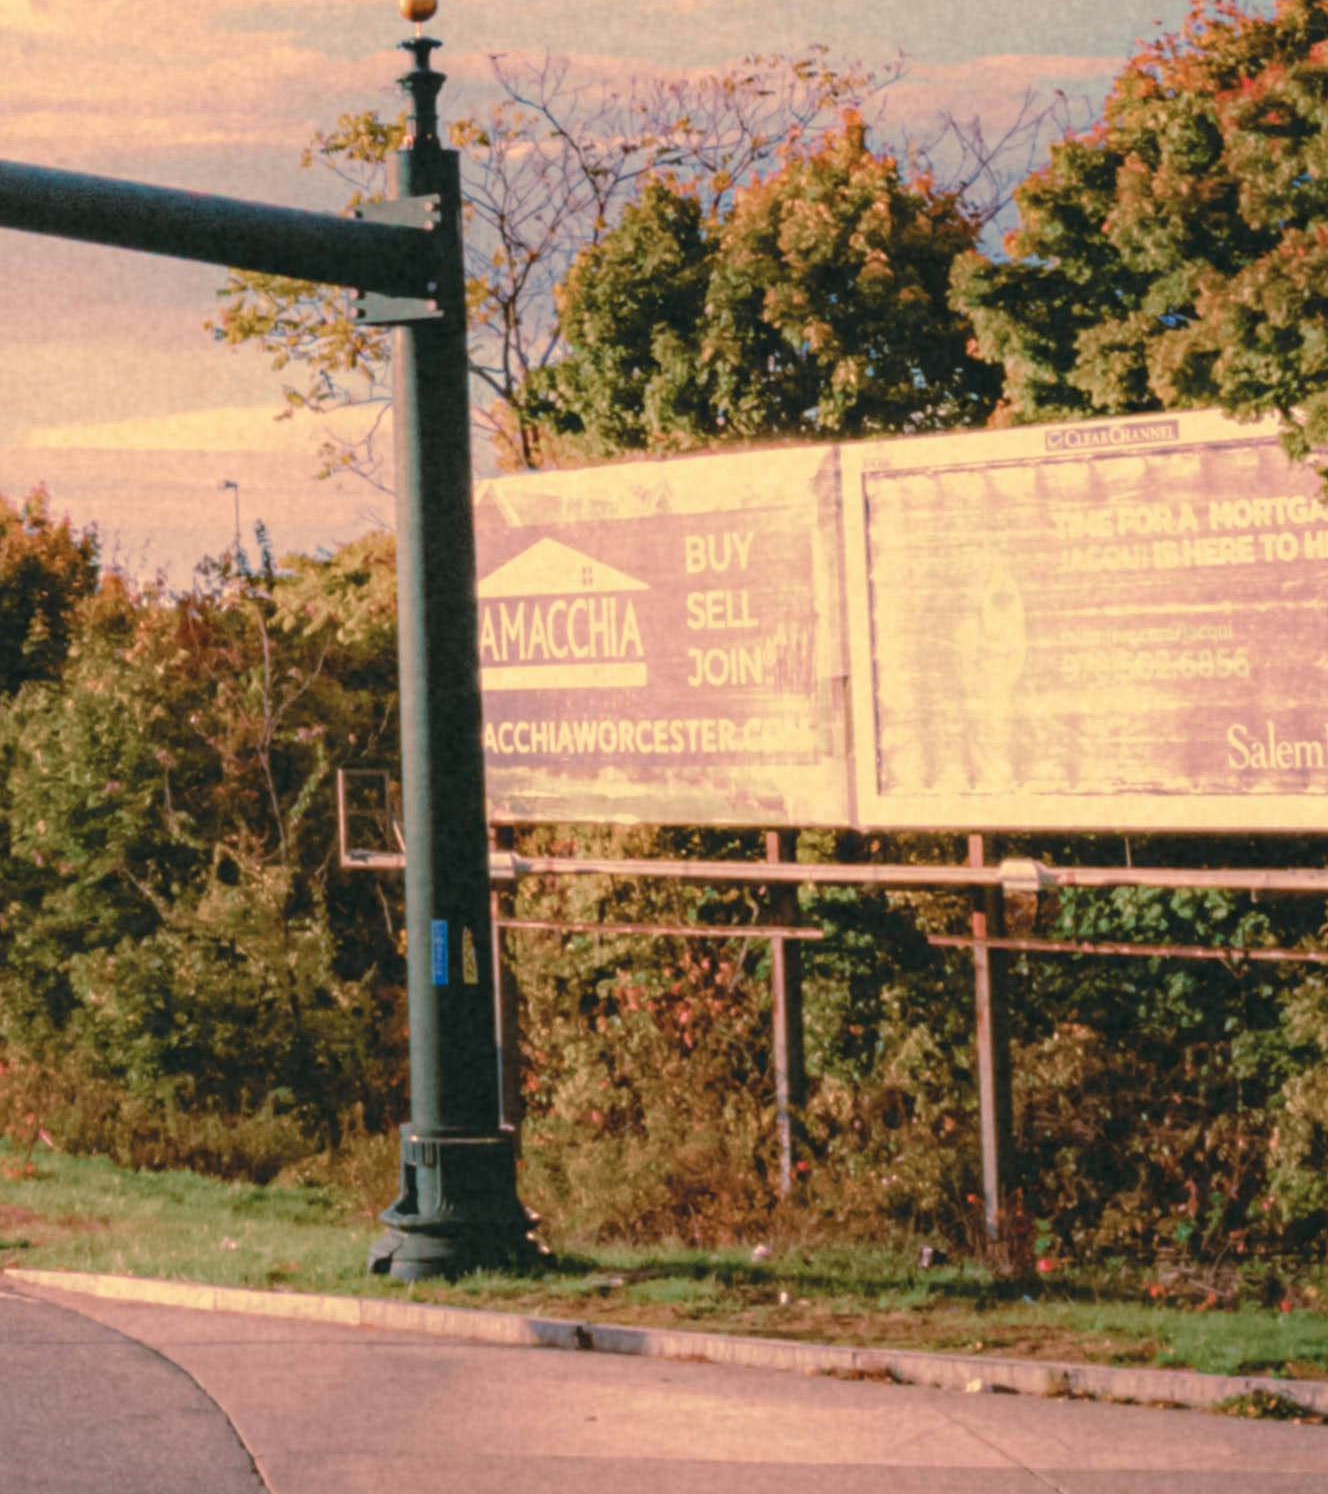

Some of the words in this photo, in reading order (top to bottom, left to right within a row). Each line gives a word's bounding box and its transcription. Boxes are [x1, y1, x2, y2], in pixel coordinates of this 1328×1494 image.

[1116, 503, 1174, 536] FOR
[1176, 500, 1200, 533] A
[684, 531, 755, 574] BUY
[1182, 534, 1256, 568] HERE
[1258, 531, 1299, 563] TO
[479, 595, 645, 663] AMACCHIA
[686, 588, 759, 630] SELL
[1227, 714, 1324, 770] Salem
